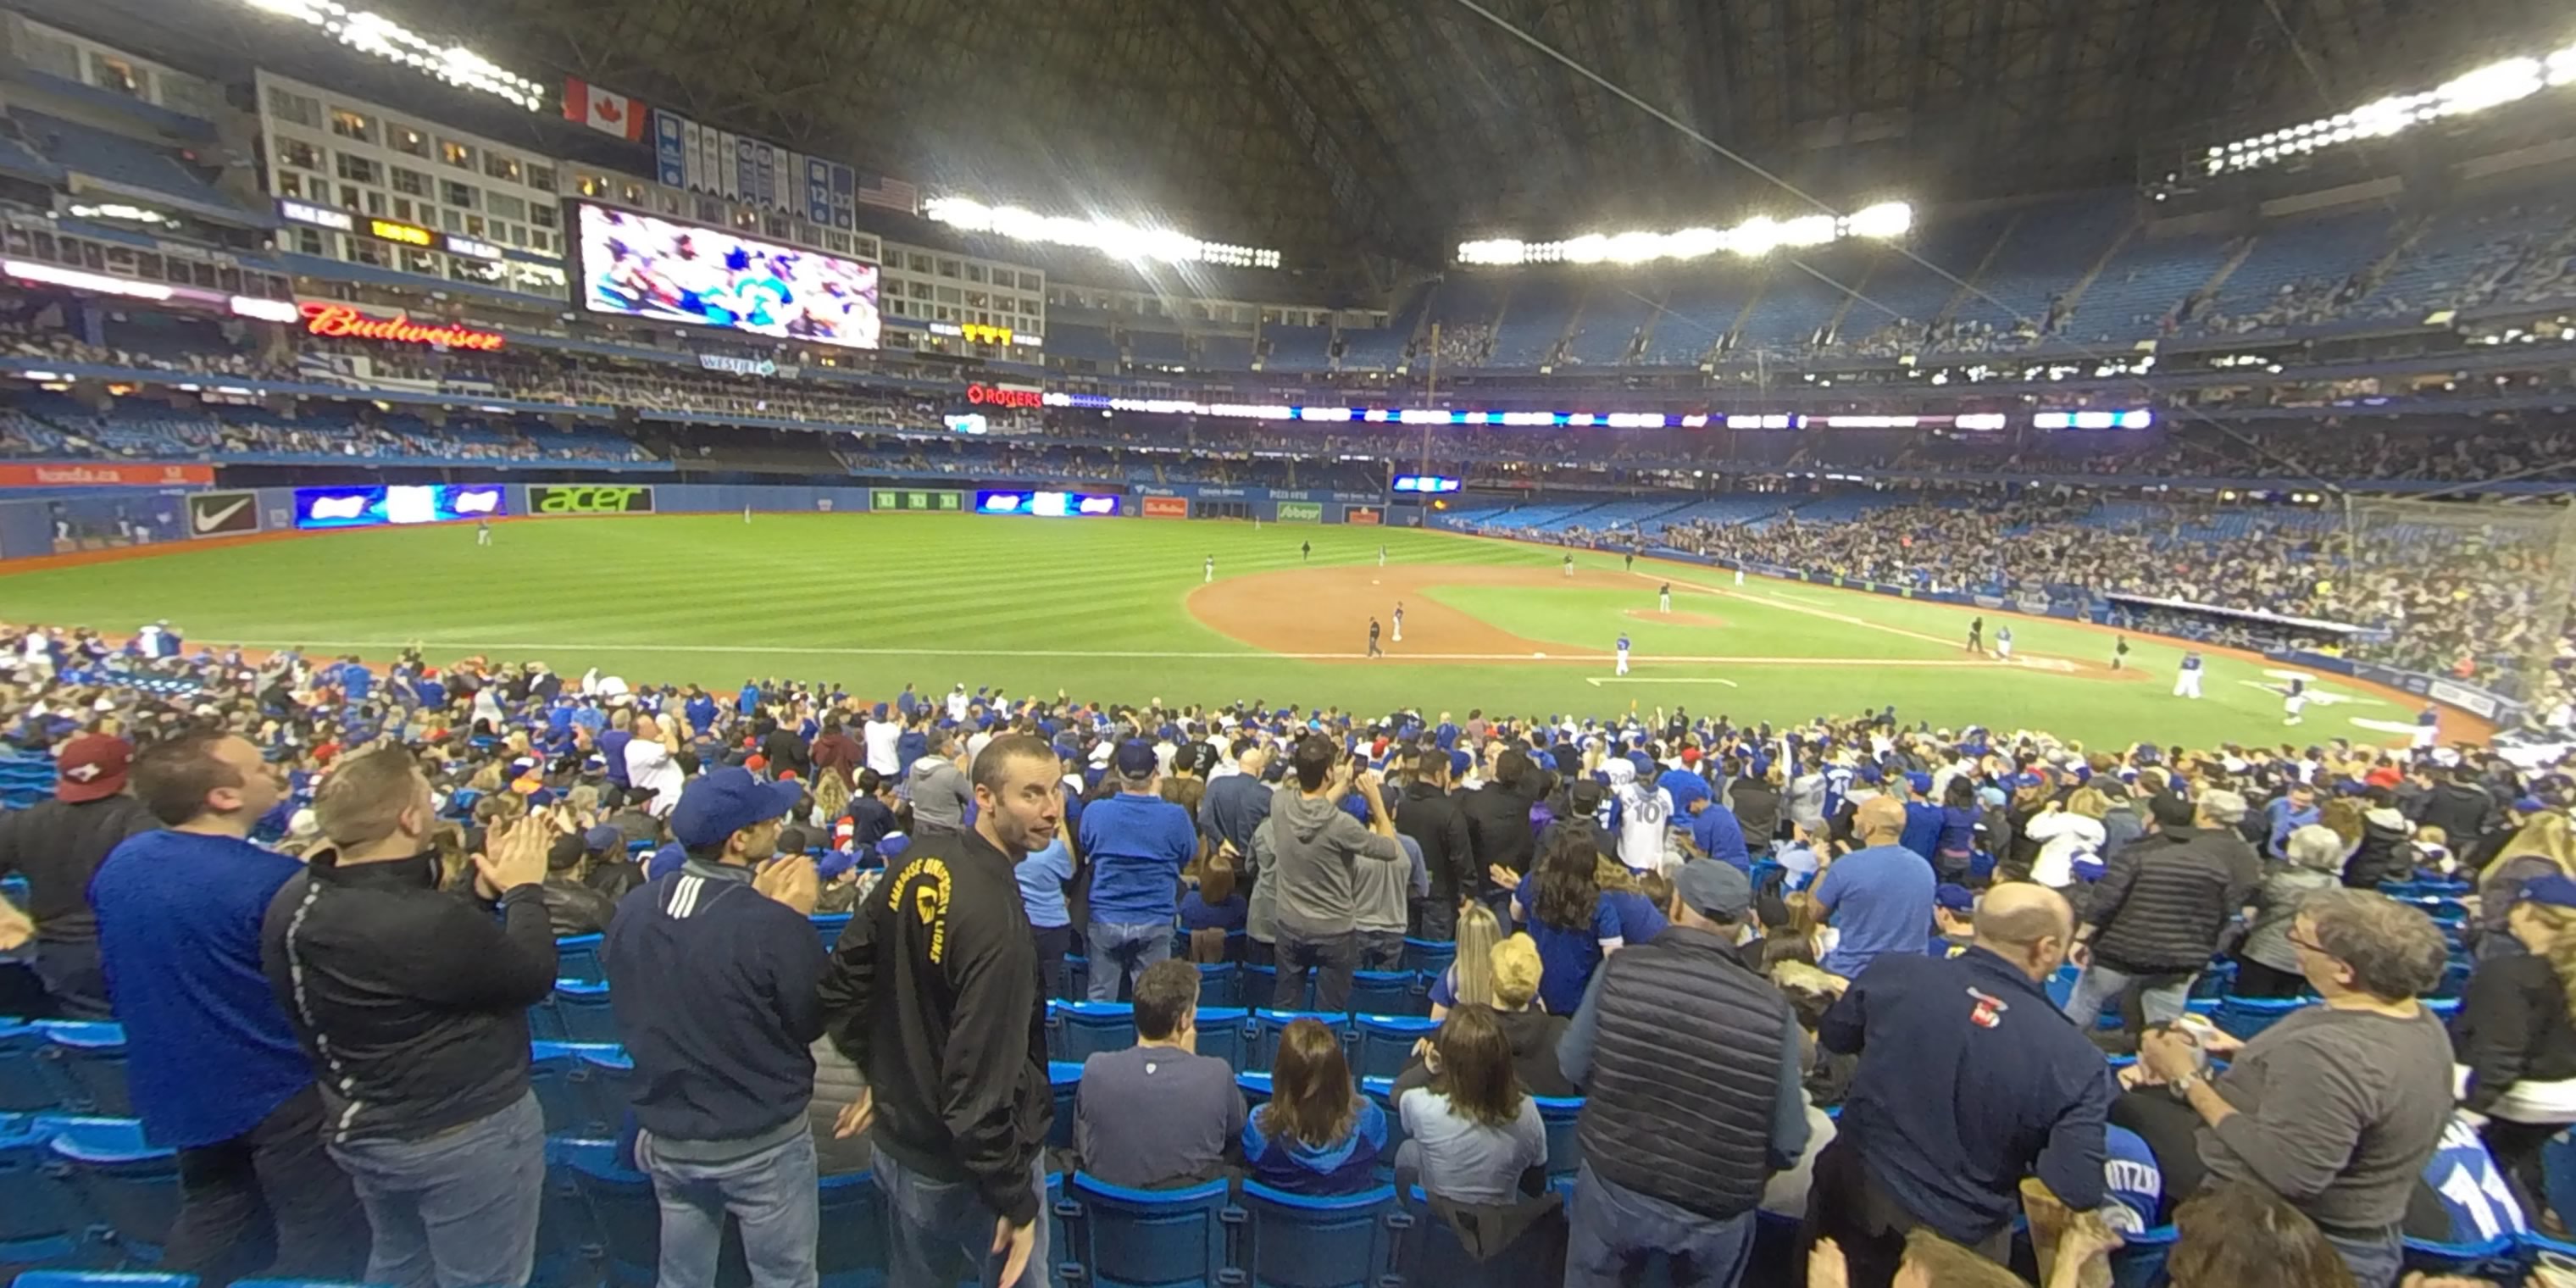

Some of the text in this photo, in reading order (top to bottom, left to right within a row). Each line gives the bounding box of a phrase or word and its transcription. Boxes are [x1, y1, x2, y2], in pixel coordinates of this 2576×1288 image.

[811, 185, 828, 204] 12
[298, 301, 507, 351] Budweiser
[985, 388, 1042, 408] ROGERS
[541, 487, 642, 513] acer
[1634, 802, 1661, 824] 10
[930, 919, 946, 965] LIONS
